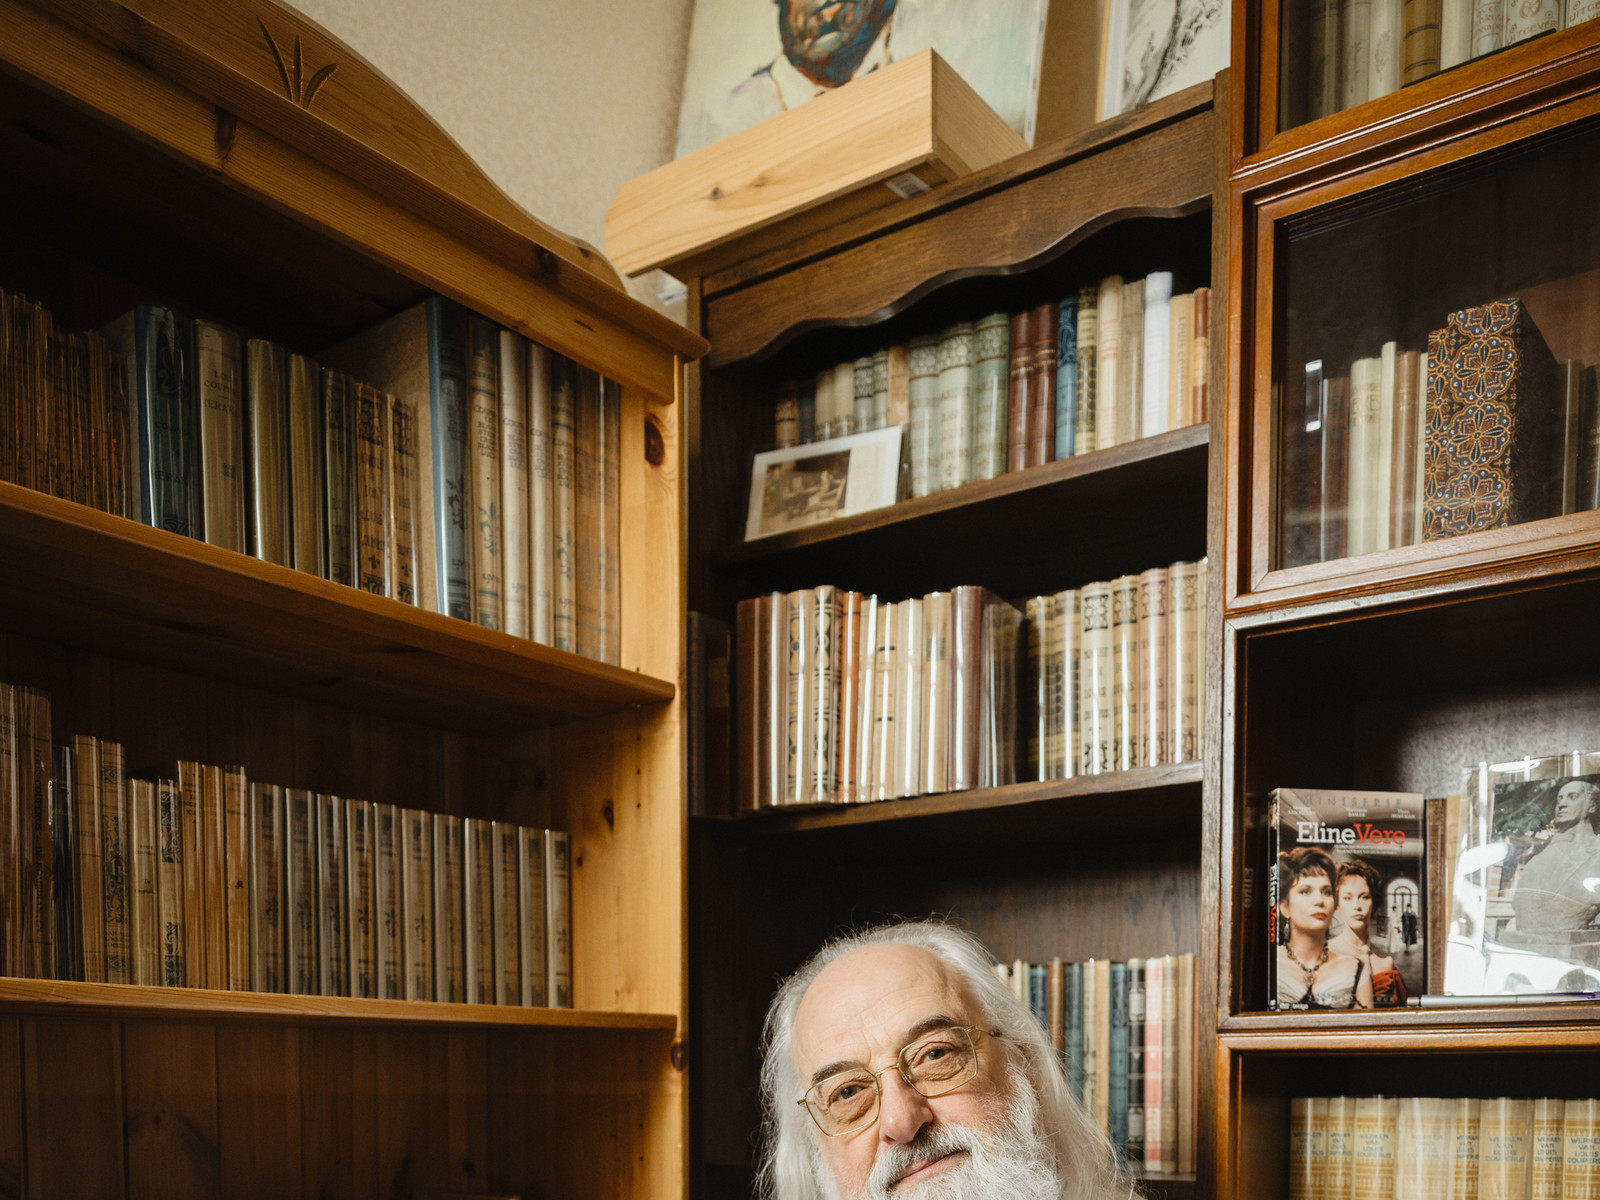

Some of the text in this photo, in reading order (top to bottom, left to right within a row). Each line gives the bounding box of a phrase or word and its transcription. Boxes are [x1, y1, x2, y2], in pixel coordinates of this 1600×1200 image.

[1302, 795, 1401, 809] MINISERIE
[1296, 821, 1407, 846] Eline Vere
[1270, 863, 1278, 943] Eline Vere
